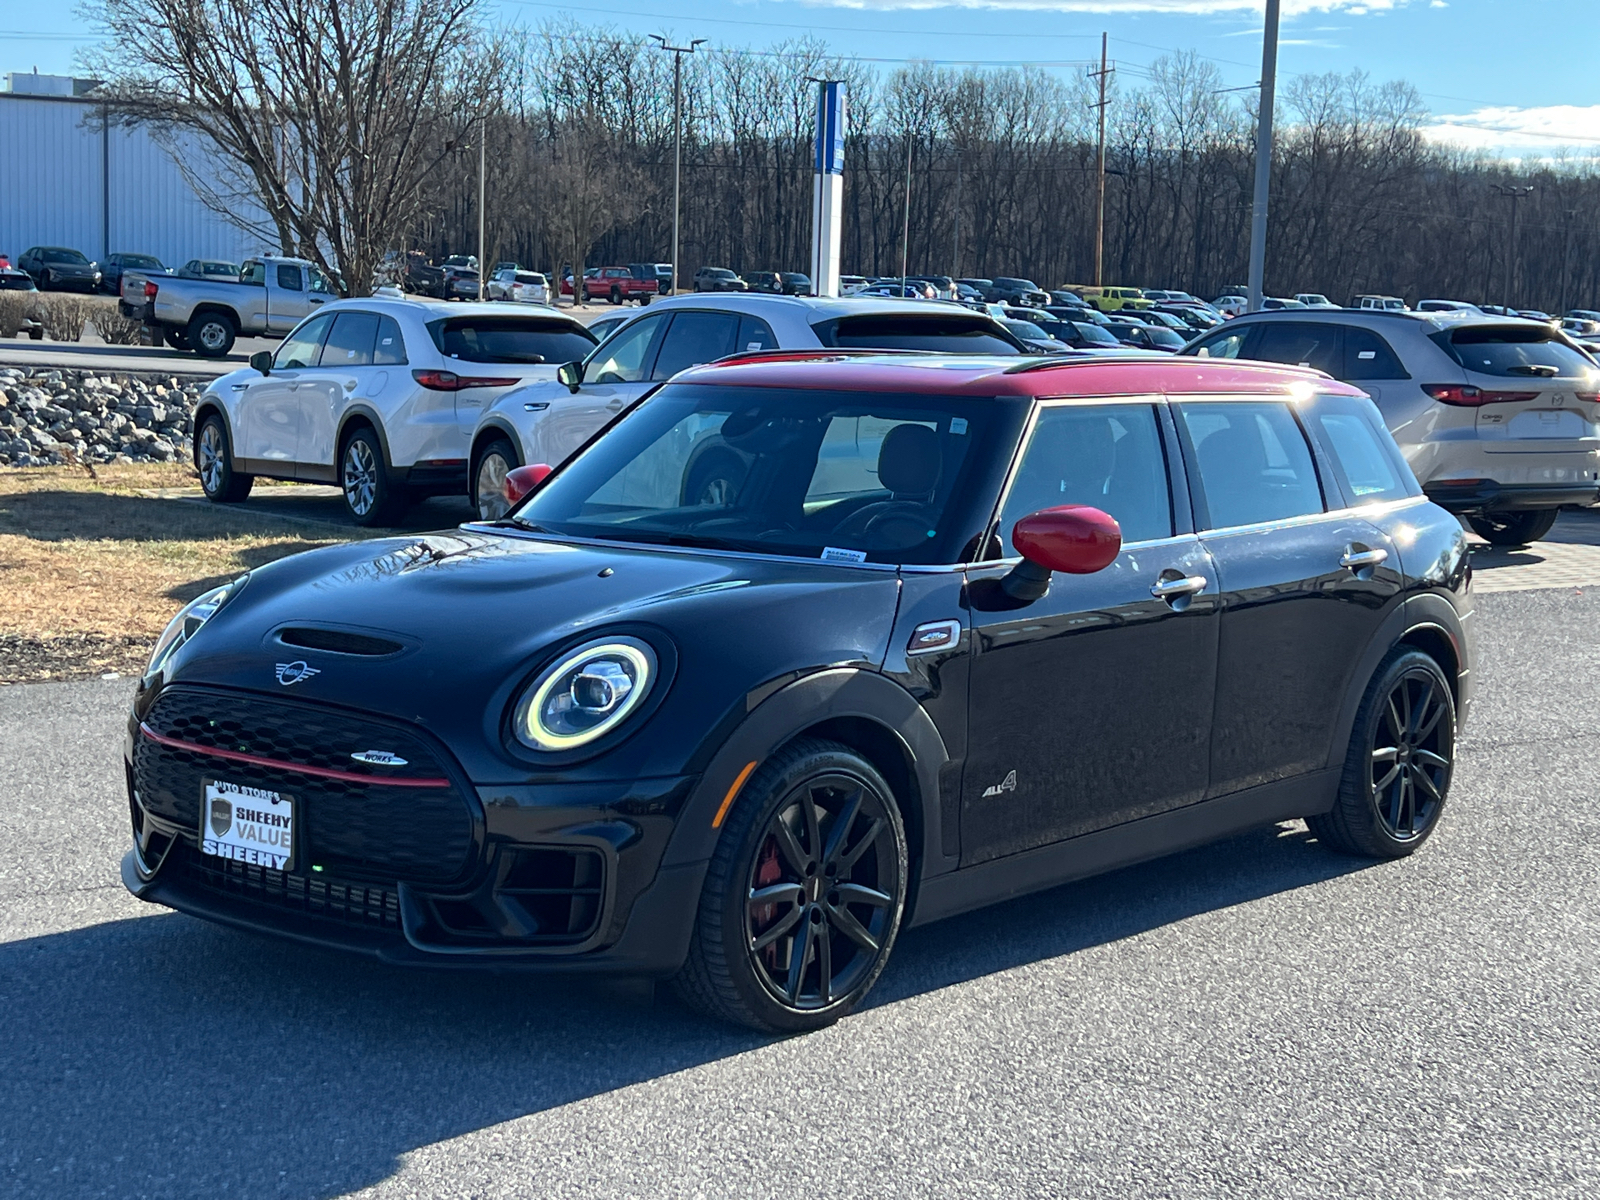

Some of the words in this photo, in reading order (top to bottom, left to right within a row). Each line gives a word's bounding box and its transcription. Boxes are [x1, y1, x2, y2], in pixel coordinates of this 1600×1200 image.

[364, 753, 393, 763] WORKS
[213, 780, 239, 794] AUTO
[240, 785, 280, 802] STORES
[236, 807, 292, 829] SHEEHY
[236, 821, 291, 849] VALUE
[202, 839, 288, 871] SHEEHY
